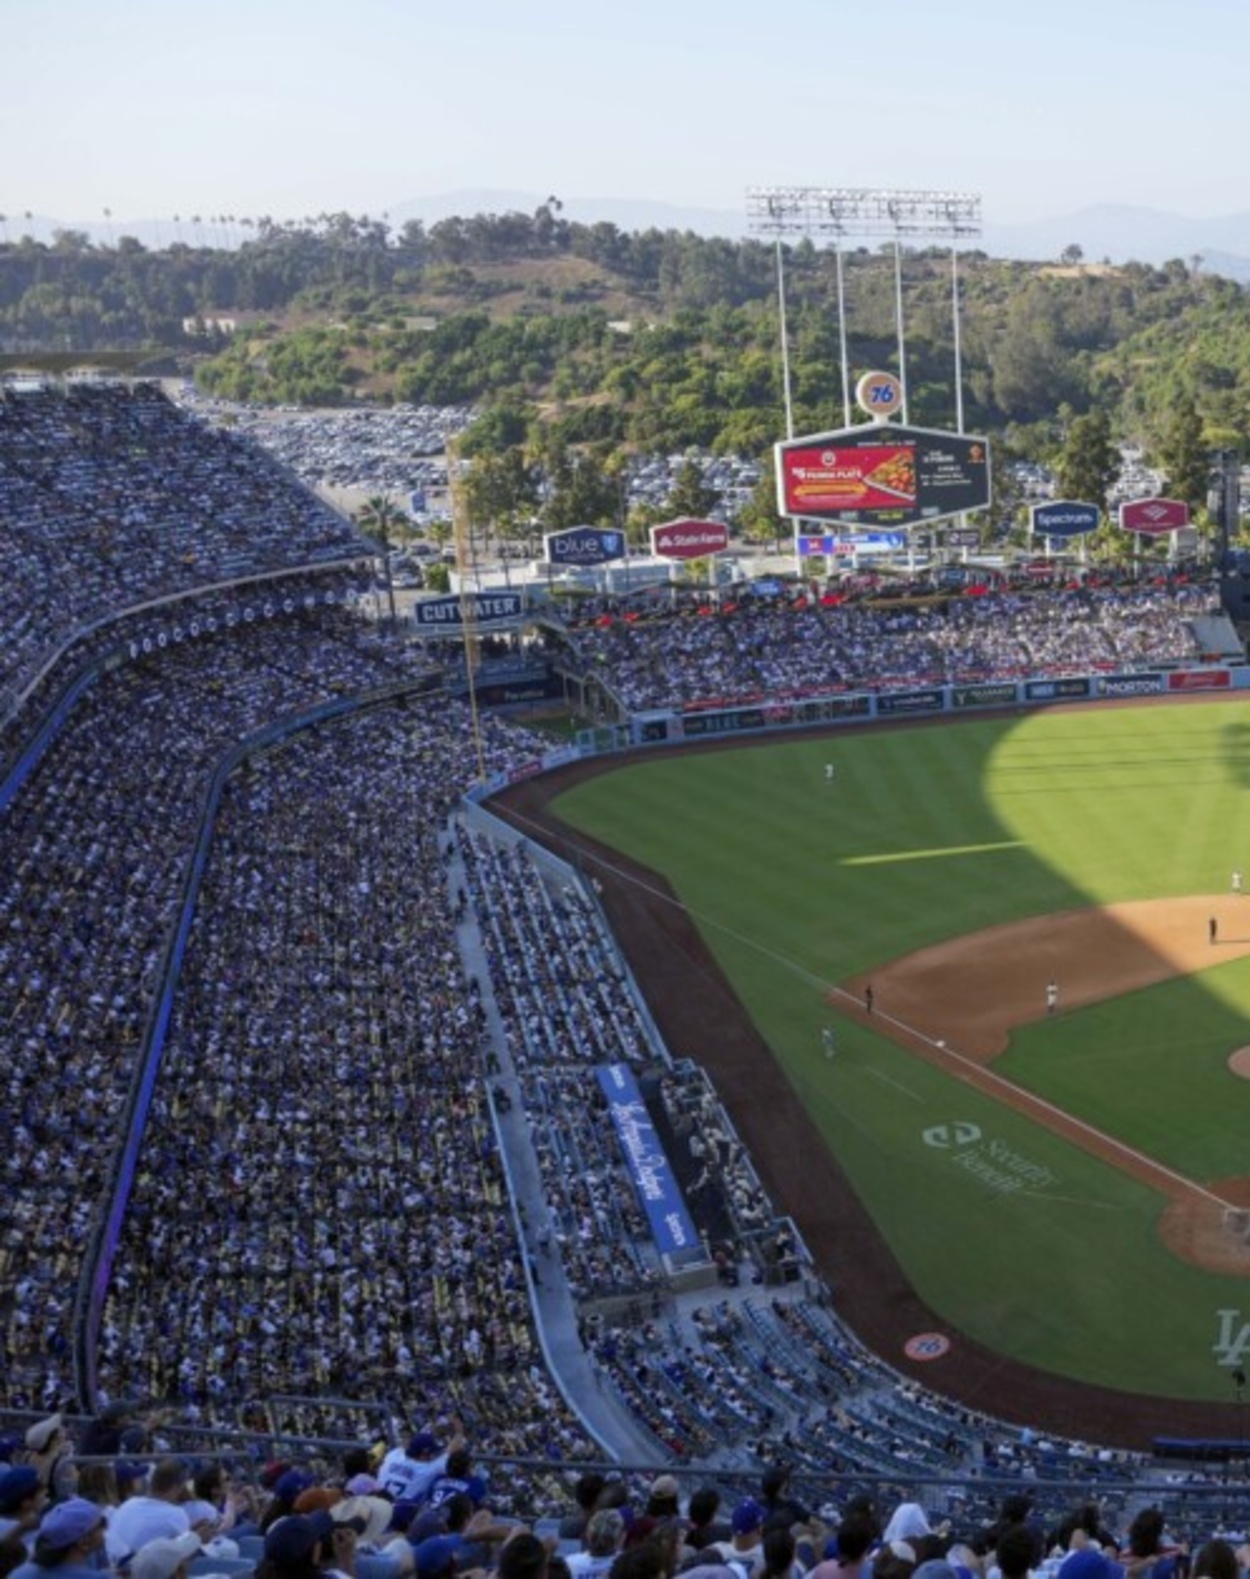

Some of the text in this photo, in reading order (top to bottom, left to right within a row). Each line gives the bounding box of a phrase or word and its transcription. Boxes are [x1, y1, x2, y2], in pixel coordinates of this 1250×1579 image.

[871, 384, 894, 402] 76
[1038, 512, 1092, 527] Spectrum
[555, 538, 599, 553] blue
[421, 598, 516, 622] CUTWATER
[1106, 680, 1161, 694] MORTON
[913, 1339, 942, 1354] 76
